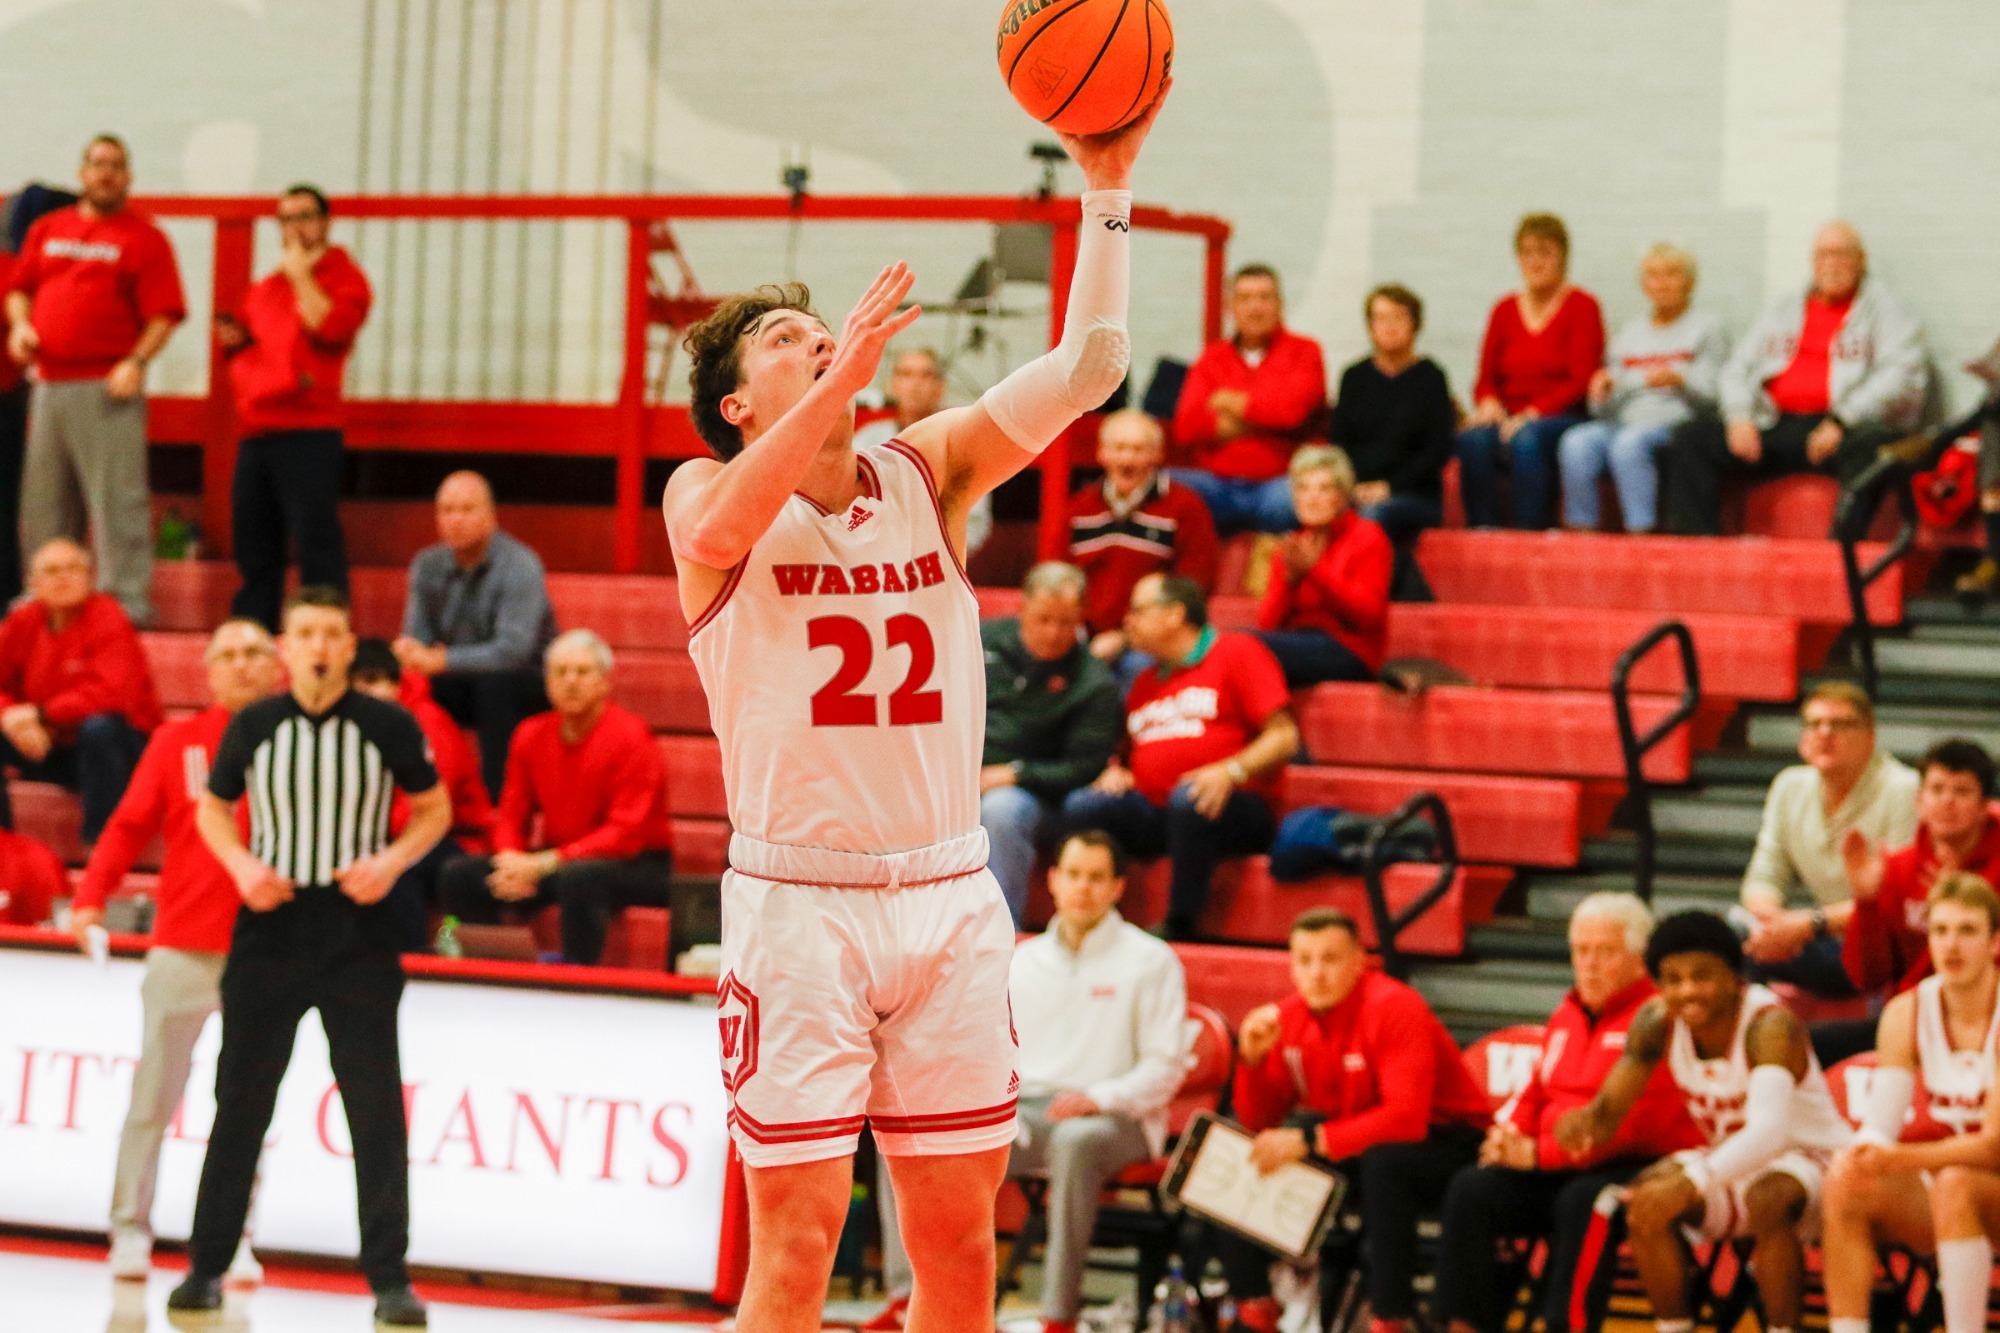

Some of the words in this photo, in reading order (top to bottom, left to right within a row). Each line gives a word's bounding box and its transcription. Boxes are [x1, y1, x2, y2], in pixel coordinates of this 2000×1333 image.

[848, 510, 874, 531] adidas
[772, 551, 945, 596] WABASH
[806, 612, 943, 727] 22
